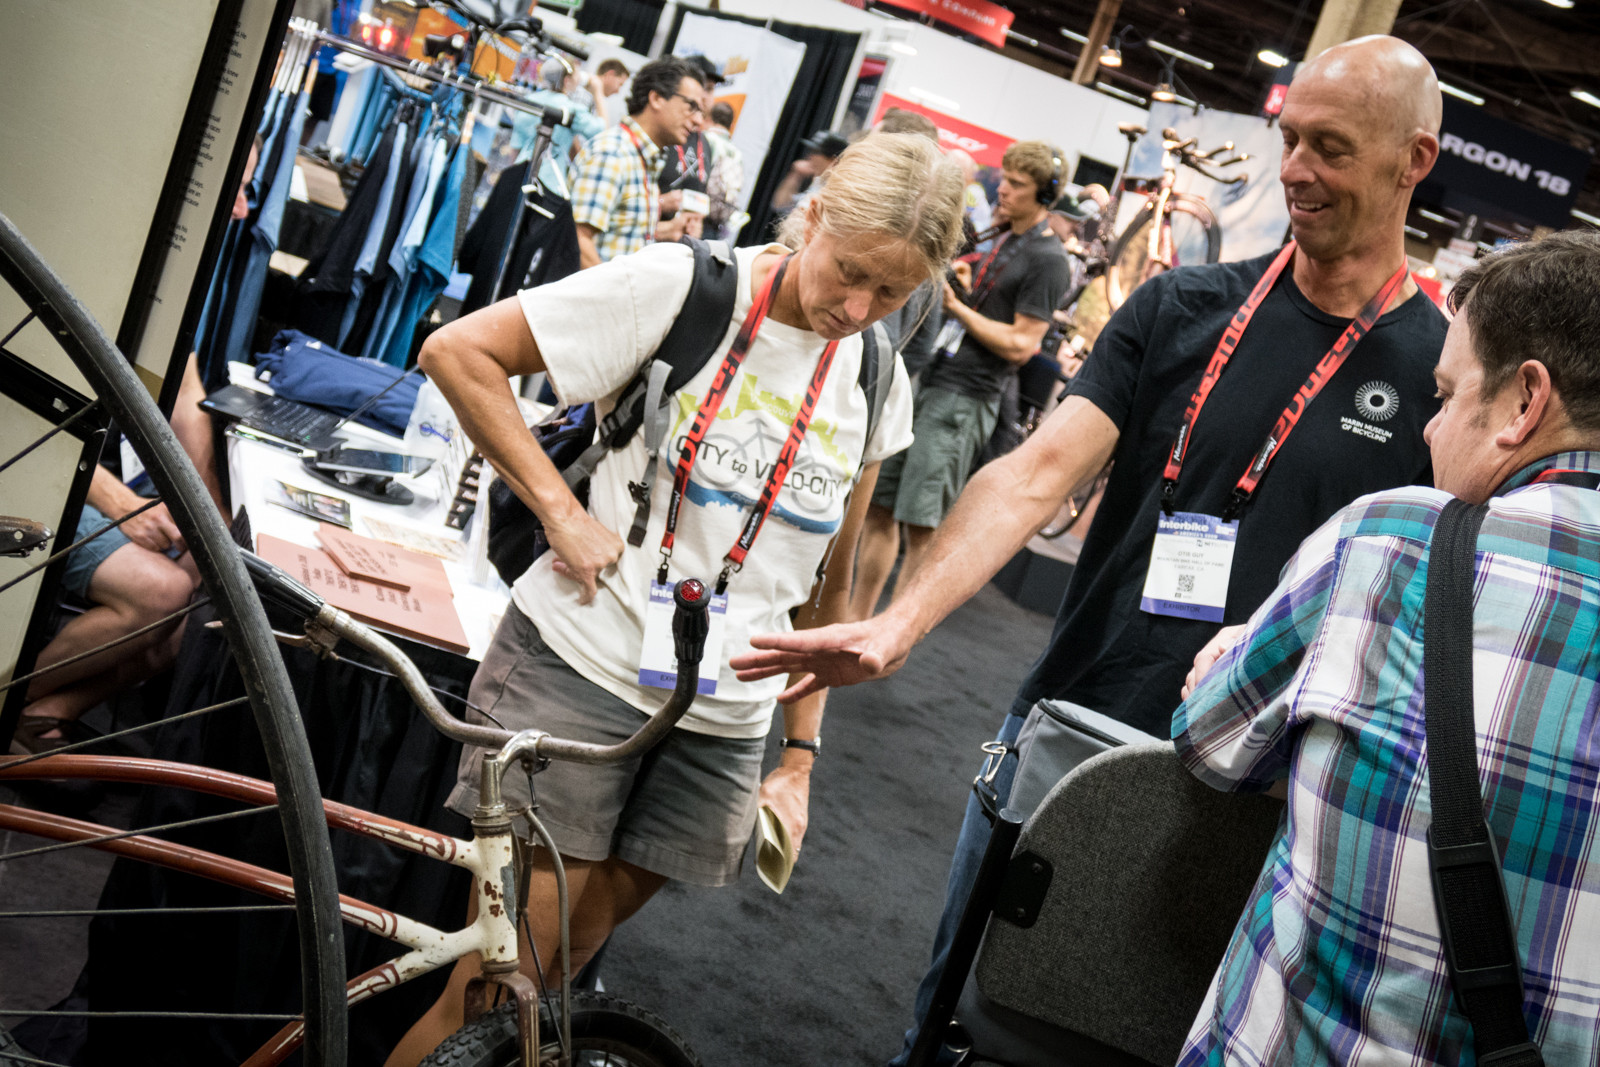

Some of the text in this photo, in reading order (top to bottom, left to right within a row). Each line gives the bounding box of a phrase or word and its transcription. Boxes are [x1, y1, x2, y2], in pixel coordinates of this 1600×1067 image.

[1440, 132, 1571, 196] RGON 18
[1341, 423, 1387, 443] OF BICYCLING
[1364, 423, 1393, 438] MUSEUM
[731, 457, 748, 474] to
[1163, 602, 1200, 613] EXHIBITOR
